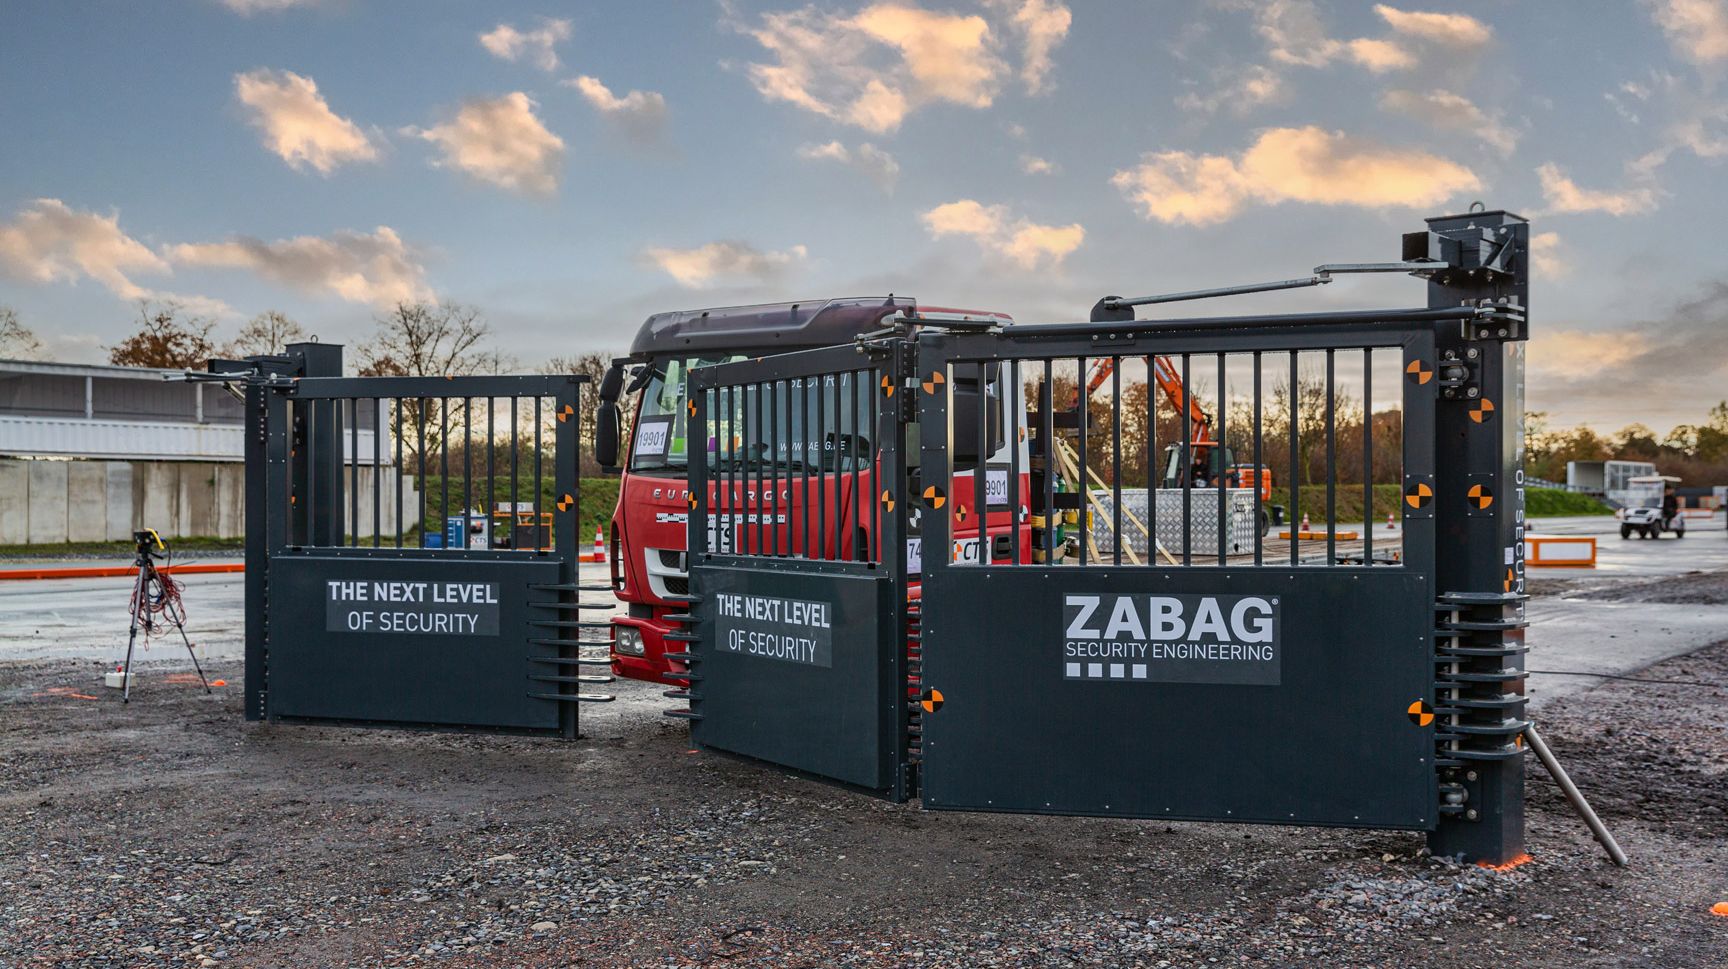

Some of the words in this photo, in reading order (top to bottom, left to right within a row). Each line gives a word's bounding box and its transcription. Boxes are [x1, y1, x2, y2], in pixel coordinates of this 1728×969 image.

[639, 431, 665, 447] 19901
[1516, 470, 1524, 501] OF
[963, 541, 989, 561] CT
[1516, 510, 1524, 622] SECURT
[328, 581, 368, 601] THE
[374, 582, 427, 602] NEXT
[433, 583, 498, 604] LEVEL
[348, 611, 374, 631] OF
[379, 612, 479, 633] SECURITY
[717, 593, 742, 618] THE
[745, 596, 781, 622] NEXT
[784, 600, 830, 629] LEVEL
[728, 628, 746, 651] OF
[749, 631, 817, 663] SECURITY
[1066, 642, 1148, 658] SECURITY
[1153, 643, 1273, 661] ENGINEERING
